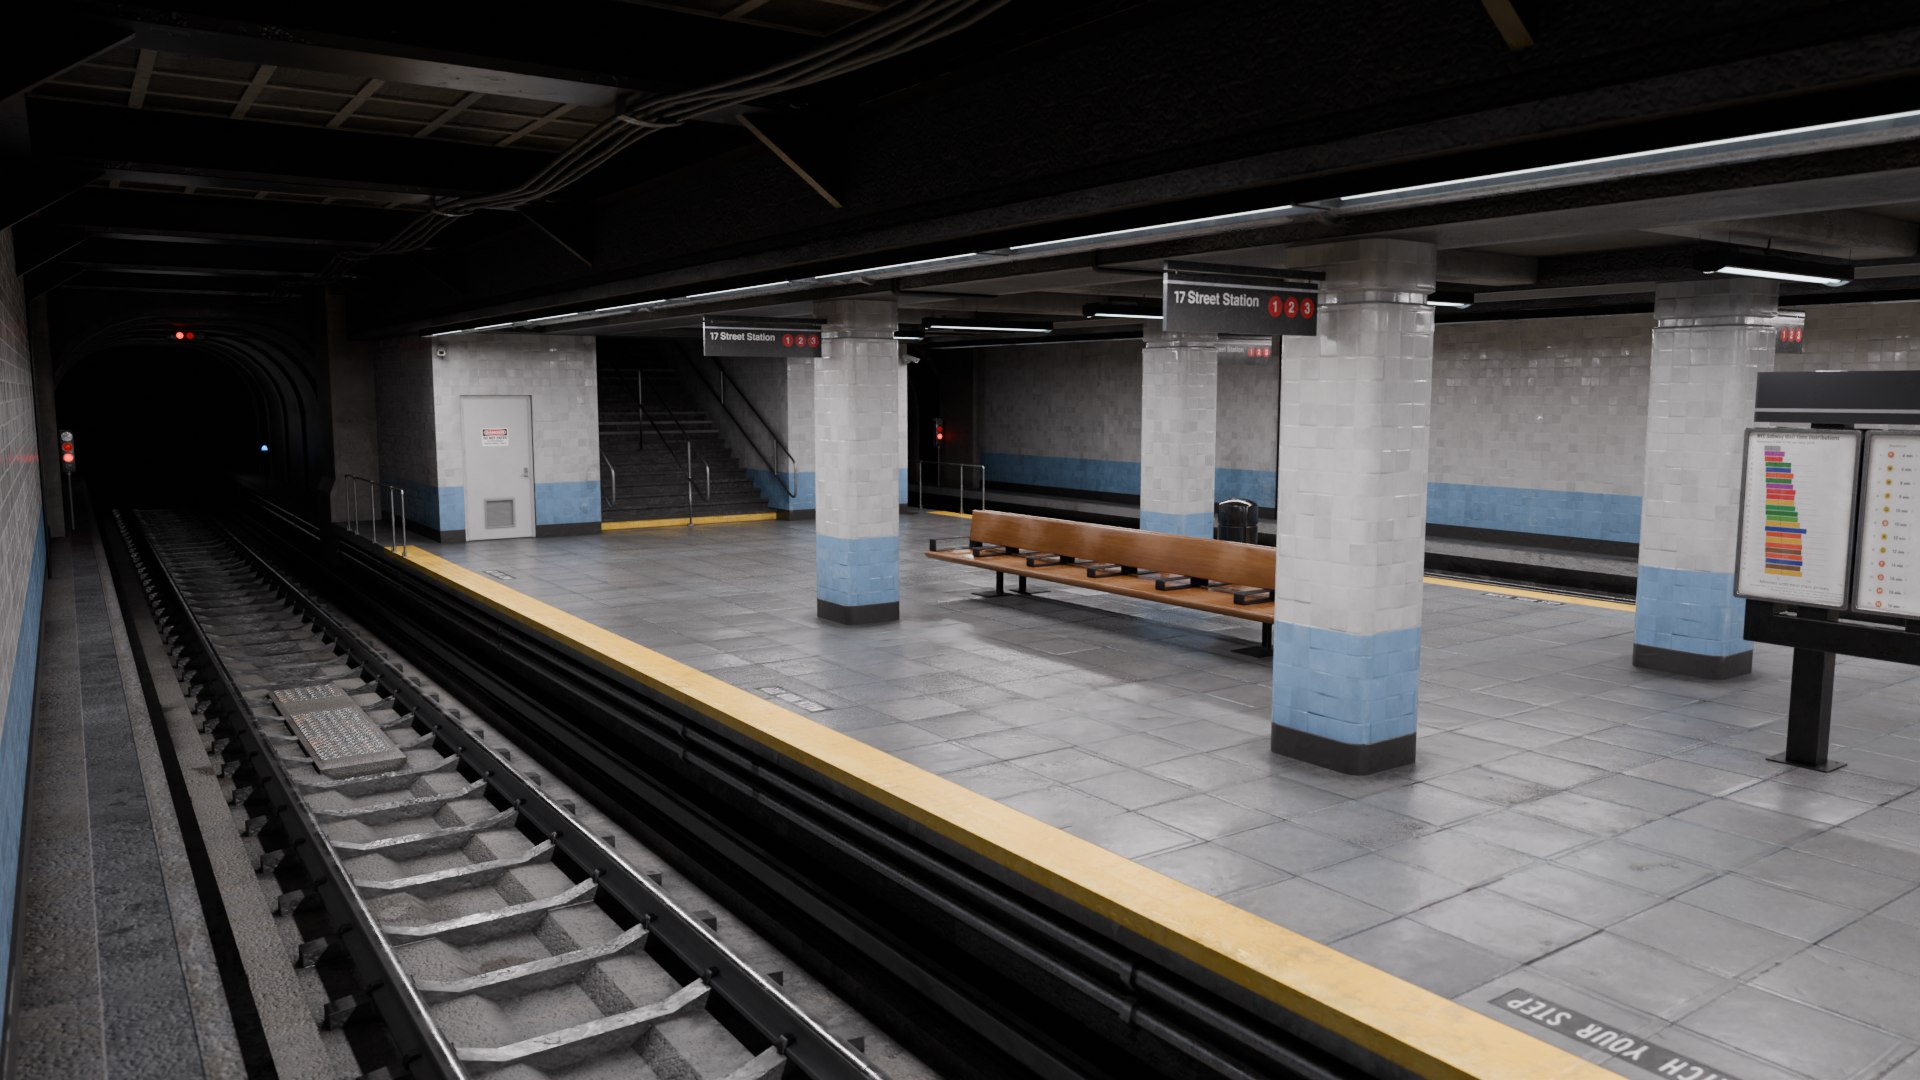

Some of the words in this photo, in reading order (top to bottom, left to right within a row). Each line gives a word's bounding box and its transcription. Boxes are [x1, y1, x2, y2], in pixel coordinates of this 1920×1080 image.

[1174, 290, 1186, 304] 17
[1187, 290, 1220, 305] Street
[1222, 292, 1259, 307] Station
[1272, 300, 1278, 313] 1
[1288, 301, 1295, 314] 2
[1304, 302, 1311, 315] 3
[709, 332, 719, 340] 17
[720, 331, 745, 341] Street
[746, 332, 776, 342] Station
[1506, 998, 1572, 1026] STEP
[1575, 1023, 1650, 1061] YOUR
